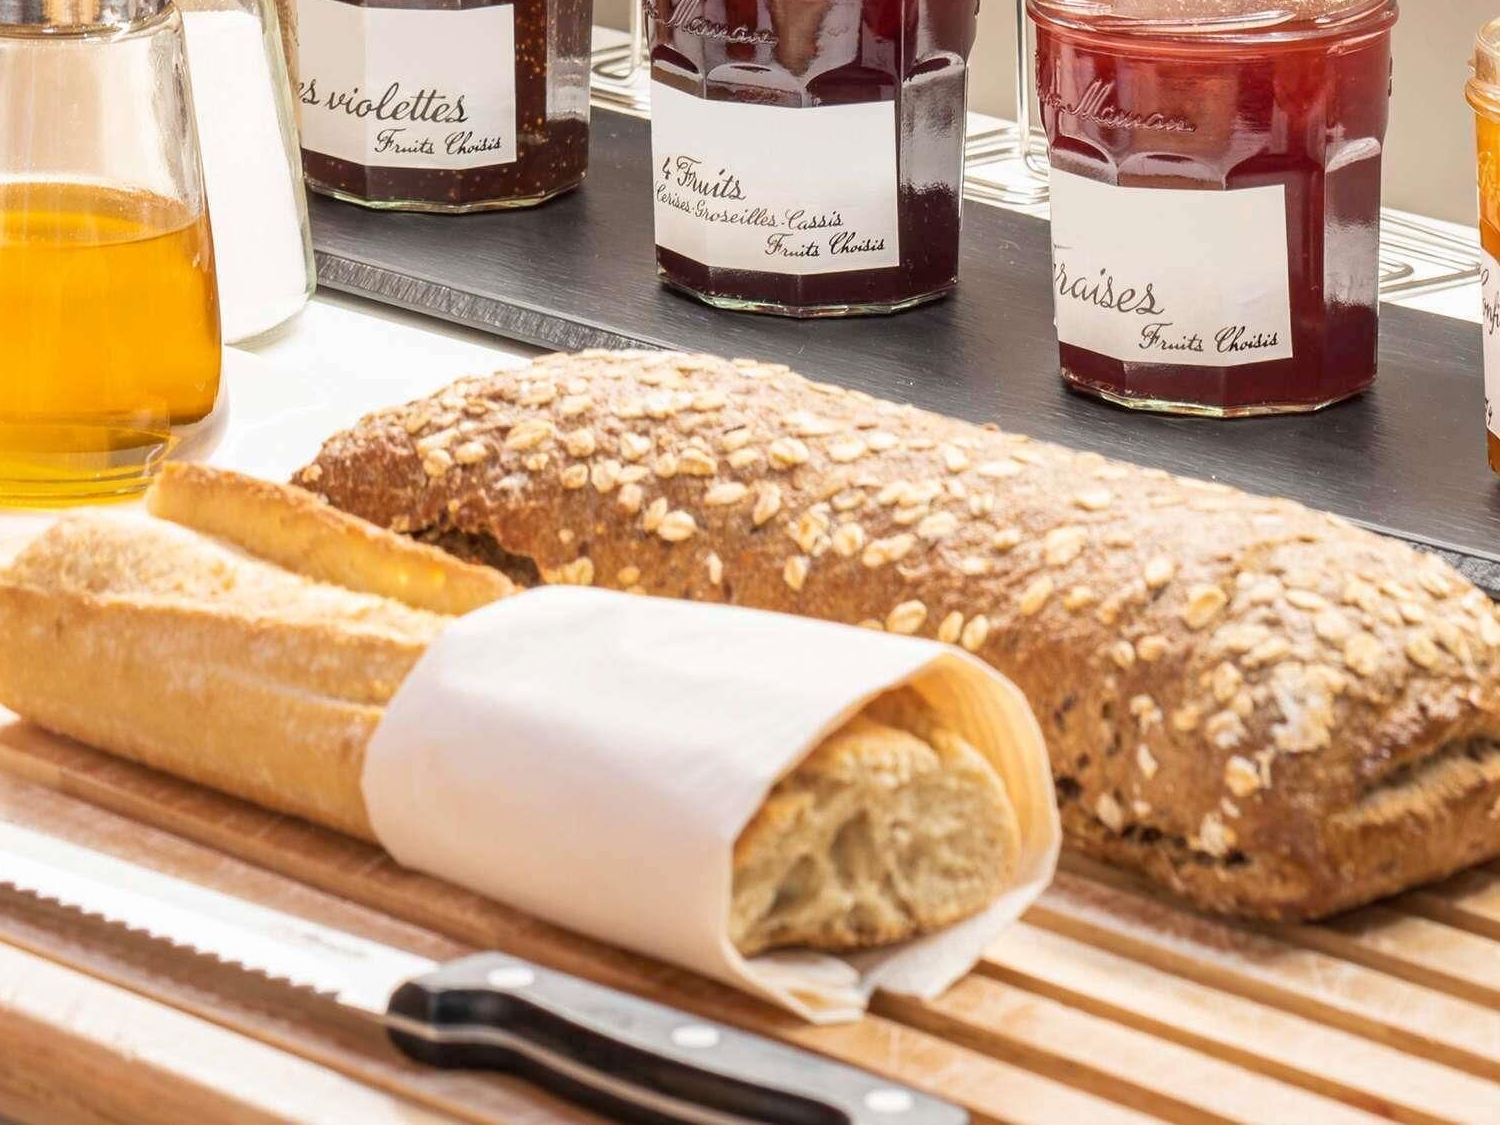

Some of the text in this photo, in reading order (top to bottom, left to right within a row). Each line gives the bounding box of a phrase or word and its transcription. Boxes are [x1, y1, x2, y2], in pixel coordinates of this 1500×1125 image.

[324, 81, 468, 124] violettes
[374, 128, 502, 155] Fruits Choisis
[662, 155, 747, 202] 4 Fruits
[764, 231, 886, 257] Fruits Choisis
[1053, 245, 1164, 316] raises
[1138, 322, 1279, 354] Fruits Choisis
